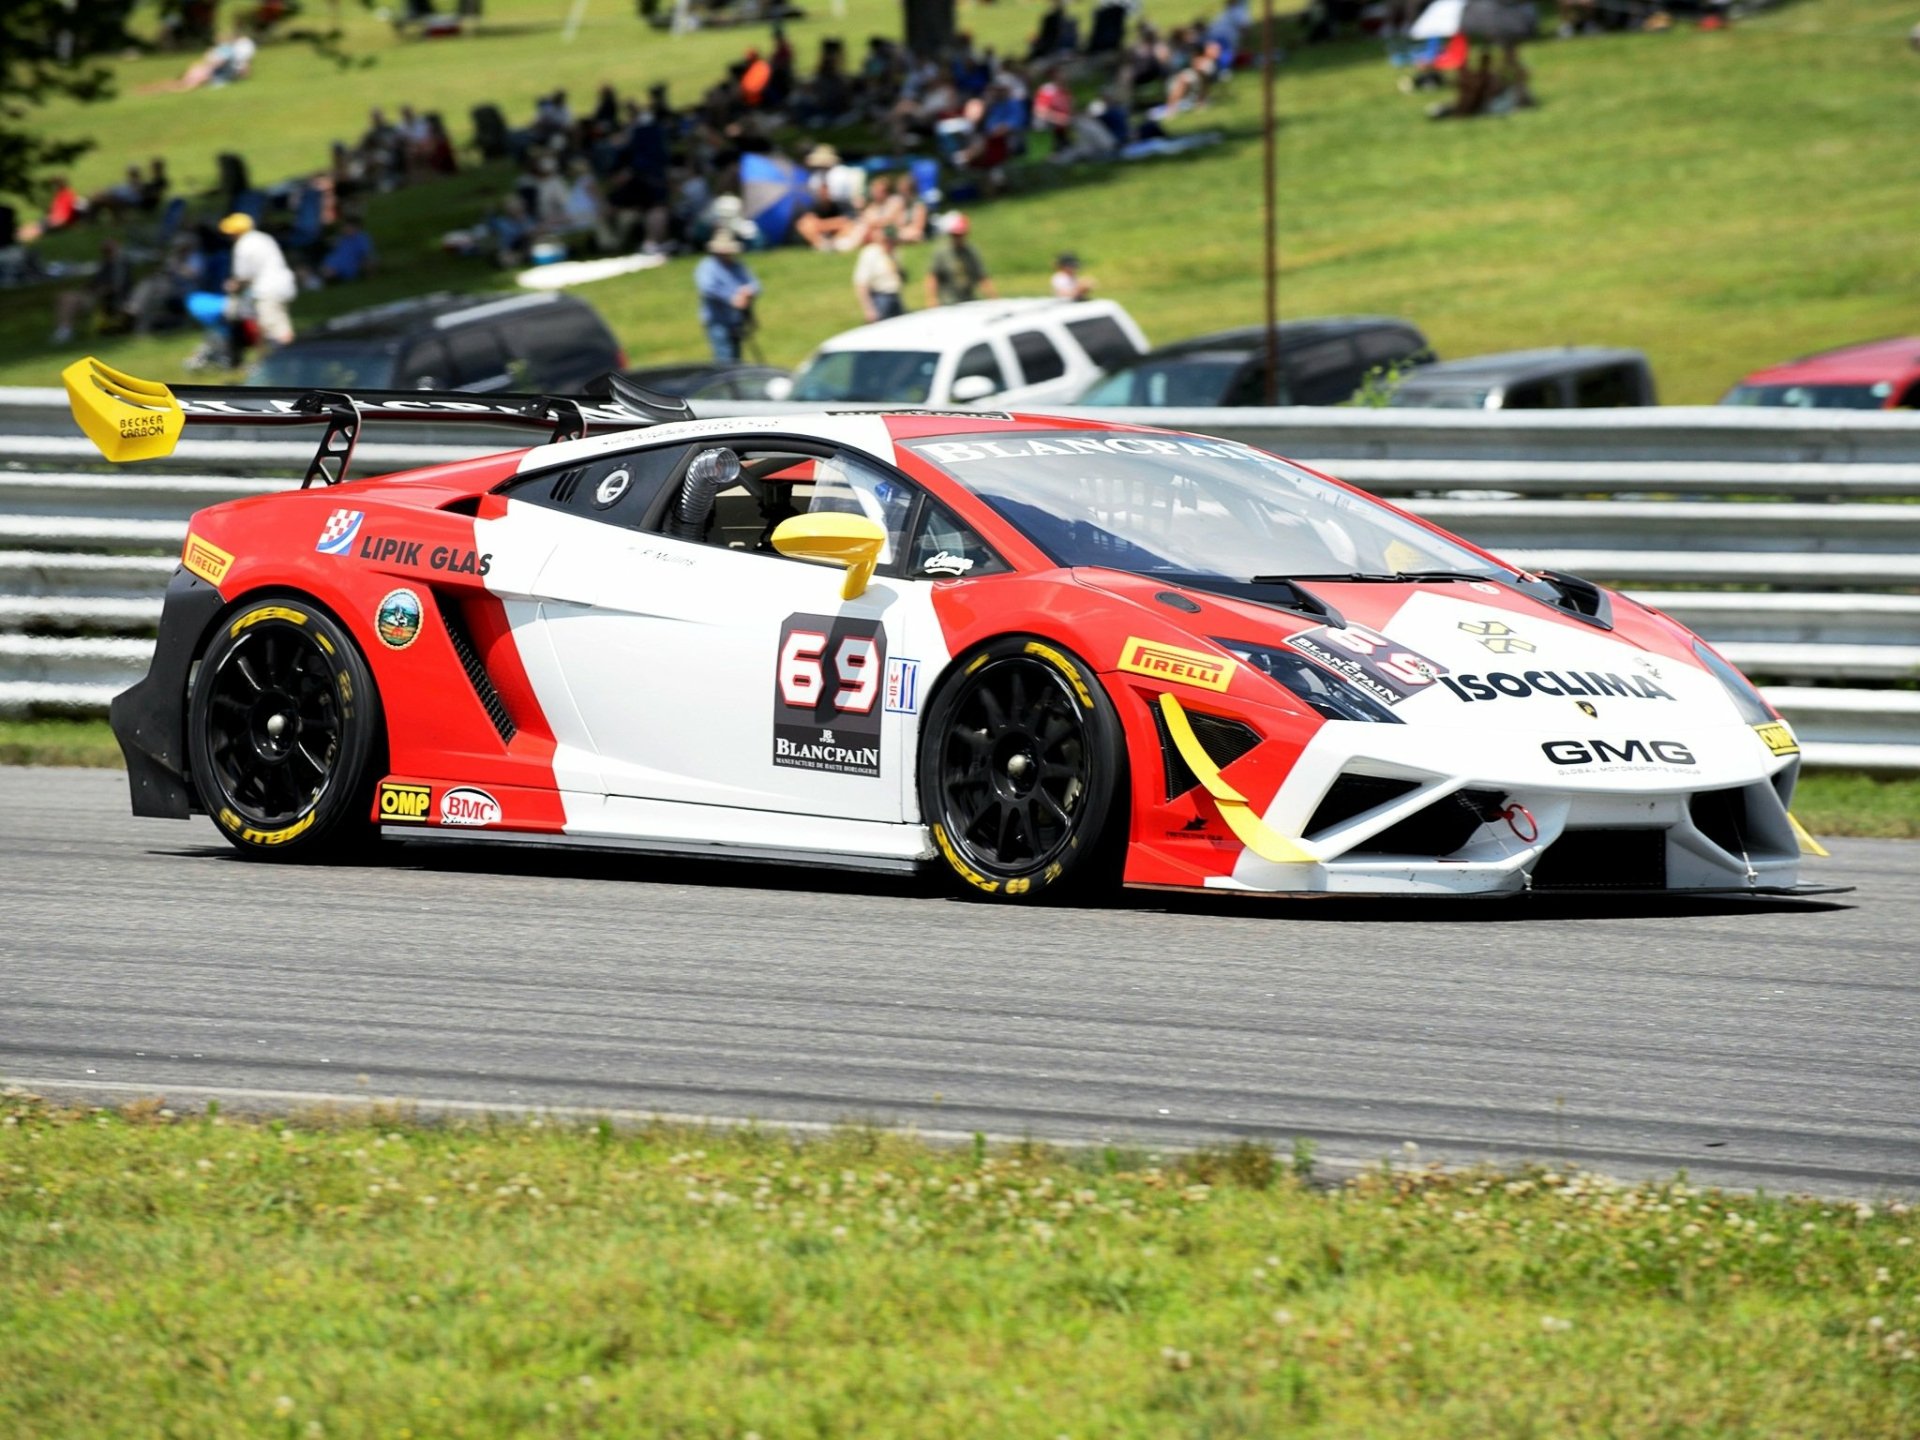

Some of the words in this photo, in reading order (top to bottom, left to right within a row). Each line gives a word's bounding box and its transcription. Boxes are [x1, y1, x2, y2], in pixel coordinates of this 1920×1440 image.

[120, 415, 164, 428] BECKER
[177, 398, 655, 425] BLACPN
[120, 425, 165, 439] CARBON
[188, 543, 226, 578] PIRELLI
[360, 536, 423, 566] LIPIK
[430, 547, 493, 576] GLAS
[779, 630, 880, 714] 69
[1131, 646, 1224, 684] PIRELLI
[1295, 637, 1402, 702] BLANCPAIN
[1440, 671, 1677, 702] ISOCLIMA
[776, 738, 879, 766] BLANCPAIN
[1541, 740, 1697, 765] GMG
[381, 790, 430, 816] OMP
[447, 796, 494, 820] BMC
